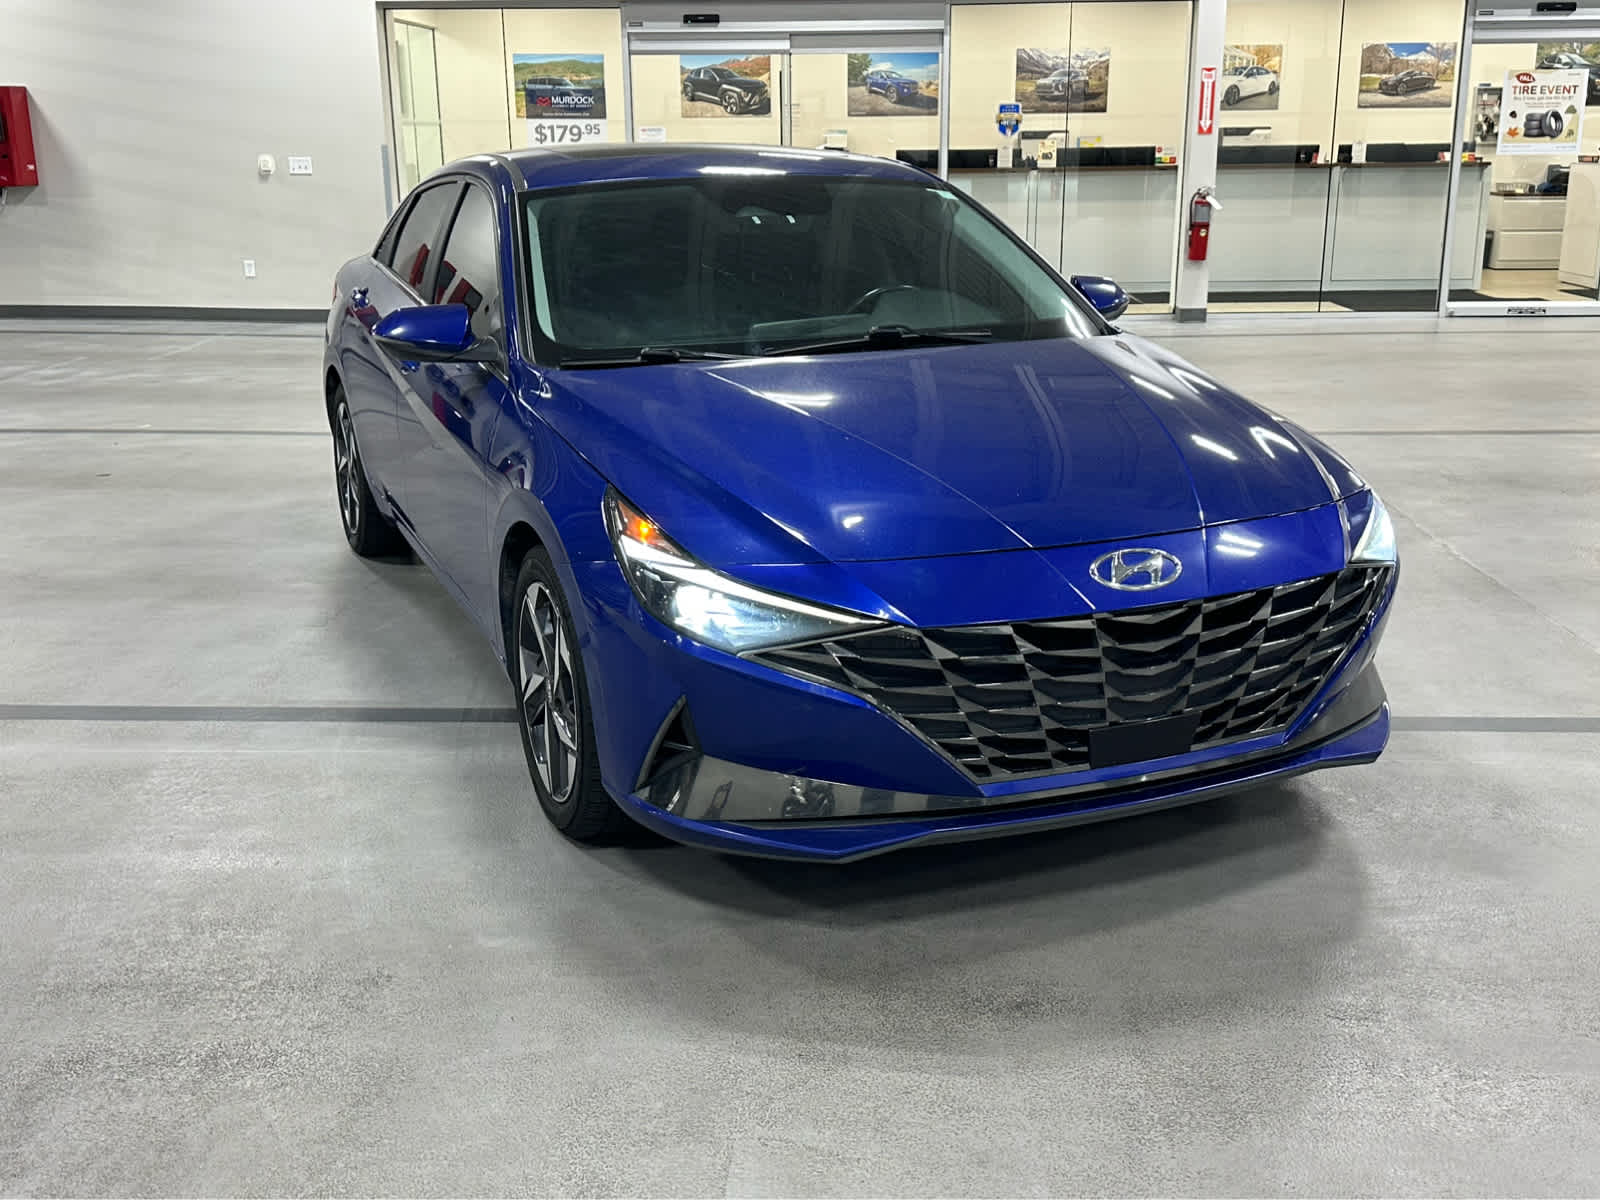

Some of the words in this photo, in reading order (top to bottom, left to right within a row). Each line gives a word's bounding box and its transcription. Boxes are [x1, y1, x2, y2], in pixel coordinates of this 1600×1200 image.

[1512, 85, 1538, 95] TIRE
[1540, 85, 1579, 95] EVENT
[551, 95, 594, 104] MURDOCK
[534, 123, 601, 144] $179.95
